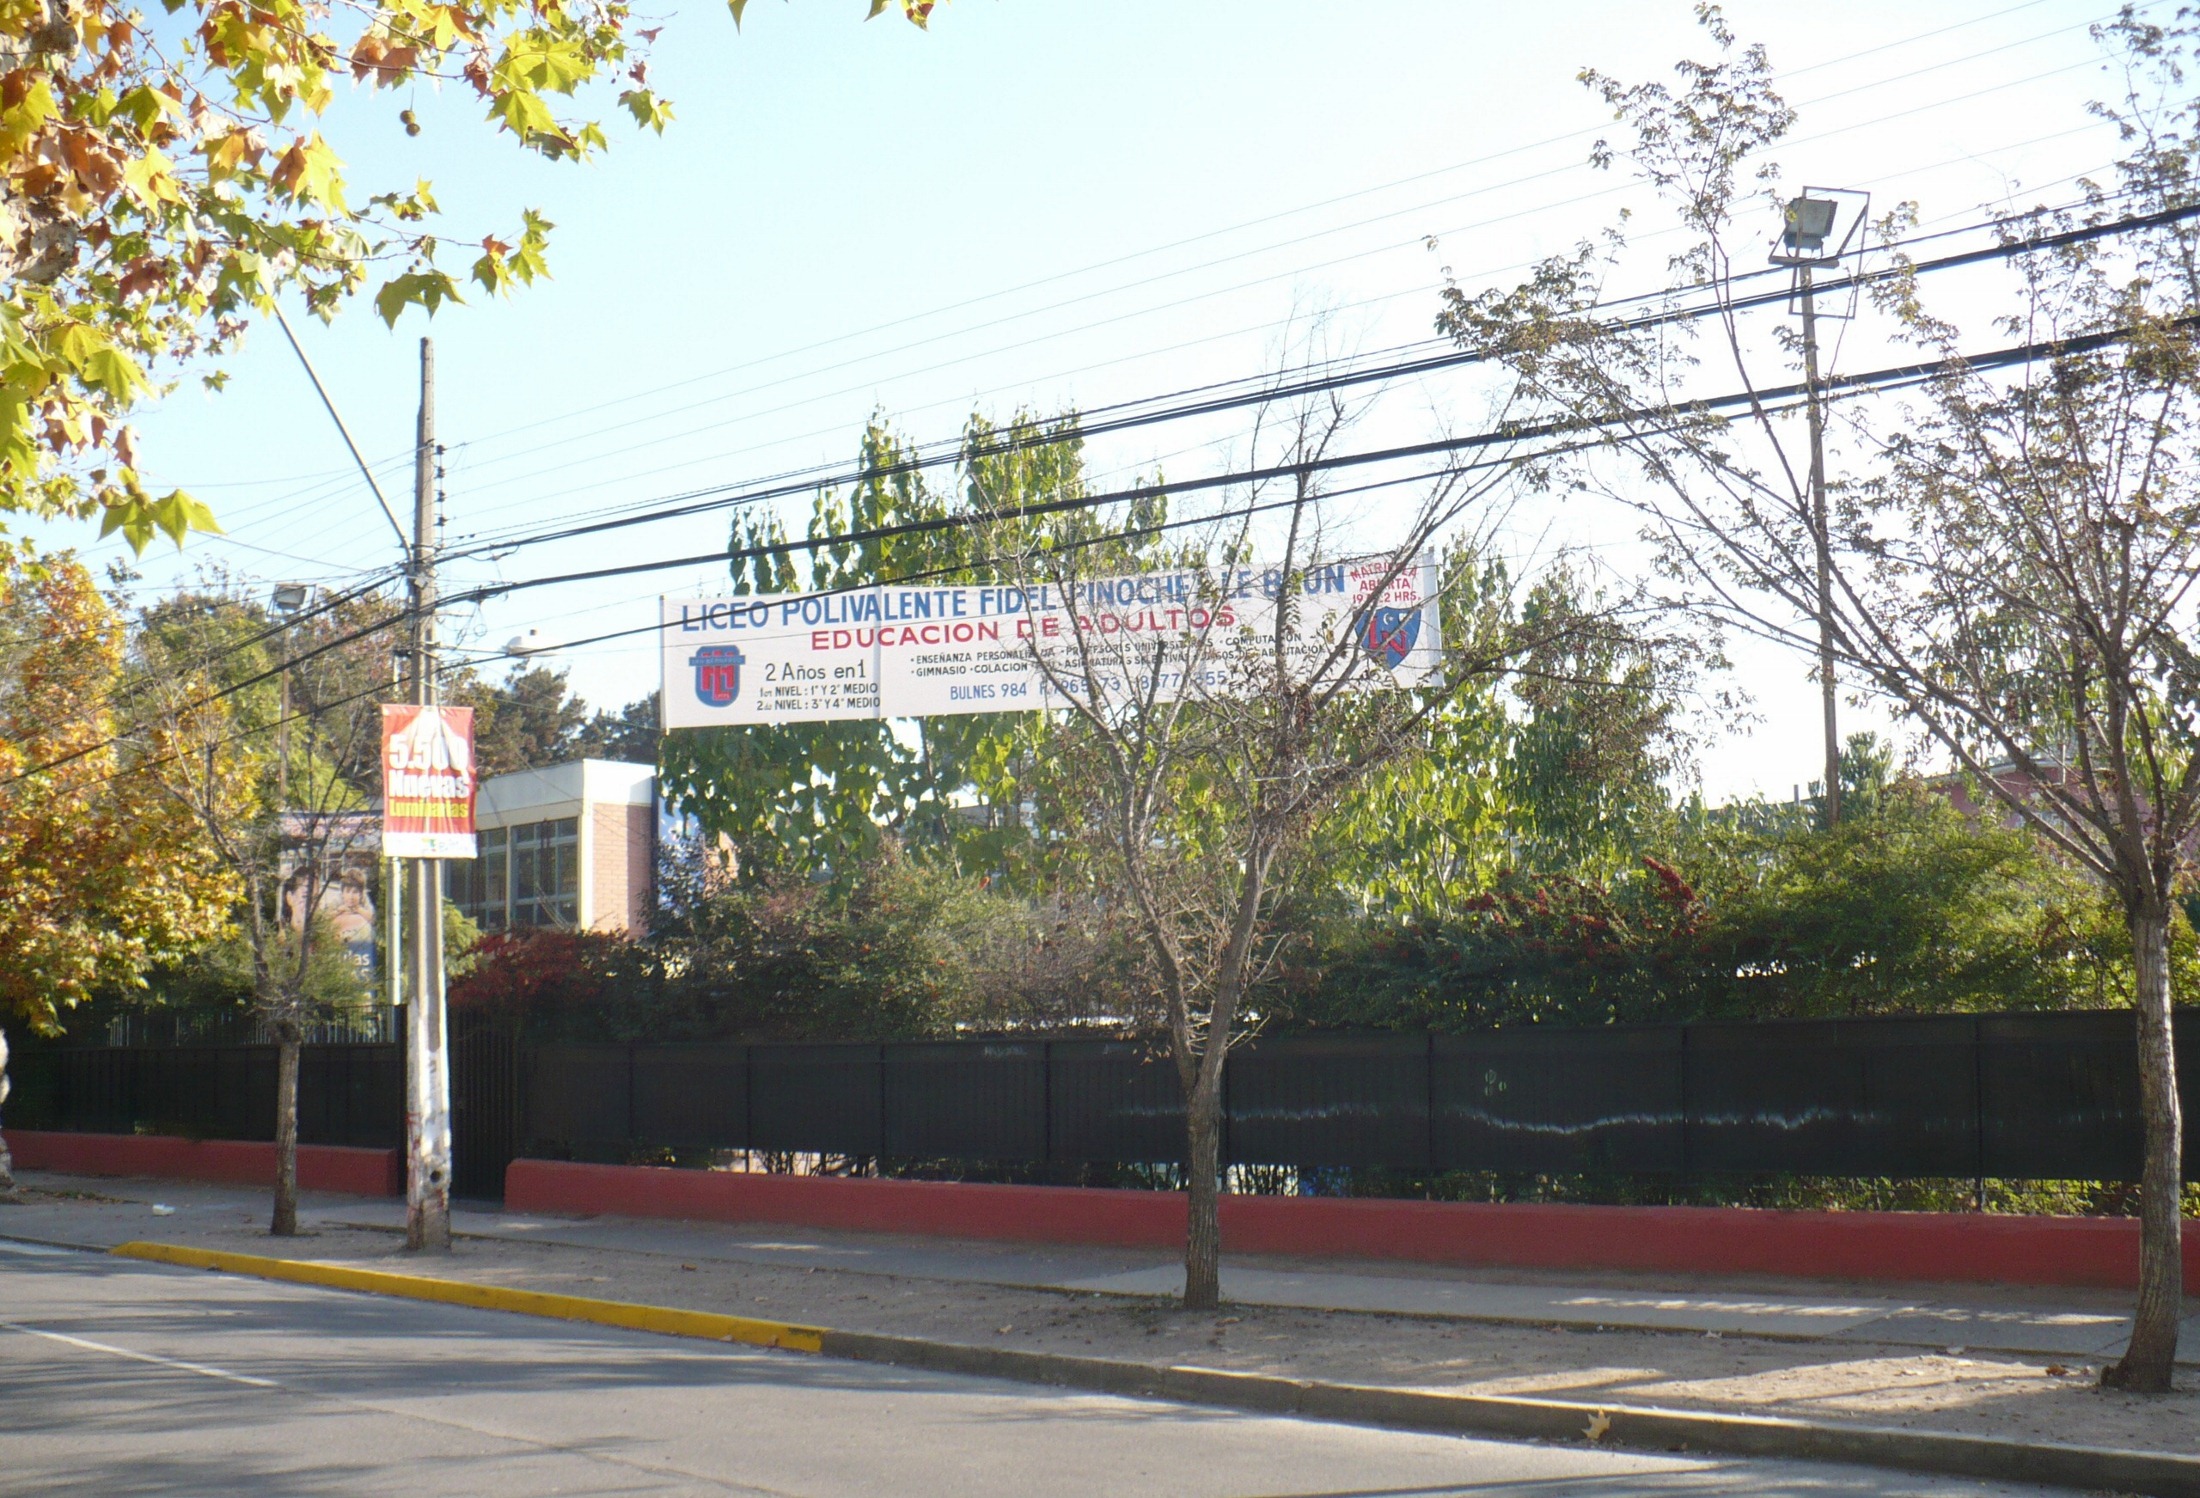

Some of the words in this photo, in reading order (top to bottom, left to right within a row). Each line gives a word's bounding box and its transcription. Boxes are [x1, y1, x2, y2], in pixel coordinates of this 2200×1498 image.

[1360, 578, 1411, 591] ABIRTA
[682, 601, 769, 632] LICEO
[782, 590, 966, 626] POLIVALENTE
[980, 585, 1057, 615] FIDEL
[1069, 574, 1206, 607] PINOCHE
[1263, 565, 1345, 597] BUN
[812, 621, 998, 650] EDUCACION
[1017, 617, 1059, 638] DE
[1073, 606, 1235, 636] ADULTOS
[916, 652, 972, 664] ENSEÑANZA
[977, 648, 1056, 661] PERSONALIZDA
[1226, 633, 1301, 645] COMPUTAON
[765, 663, 776, 682] 2
[782, 661, 826, 681] Años
[916, 665, 967, 677] GIMNASIO
[974, 662, 1028, 673] COLACION
[819, 685, 827, 695] Y
[843, 683, 878, 694] MEDIO
[950, 684, 996, 700] BULNES
[1001, 682, 1027, 698] 984
[825, 699, 832, 709] Y
[847, 697, 880, 708] MEDIO
[389, 734, 469, 771] 5.500
[388, 769, 470, 799] Nuevas
[389, 798, 469, 818] Luminarias
